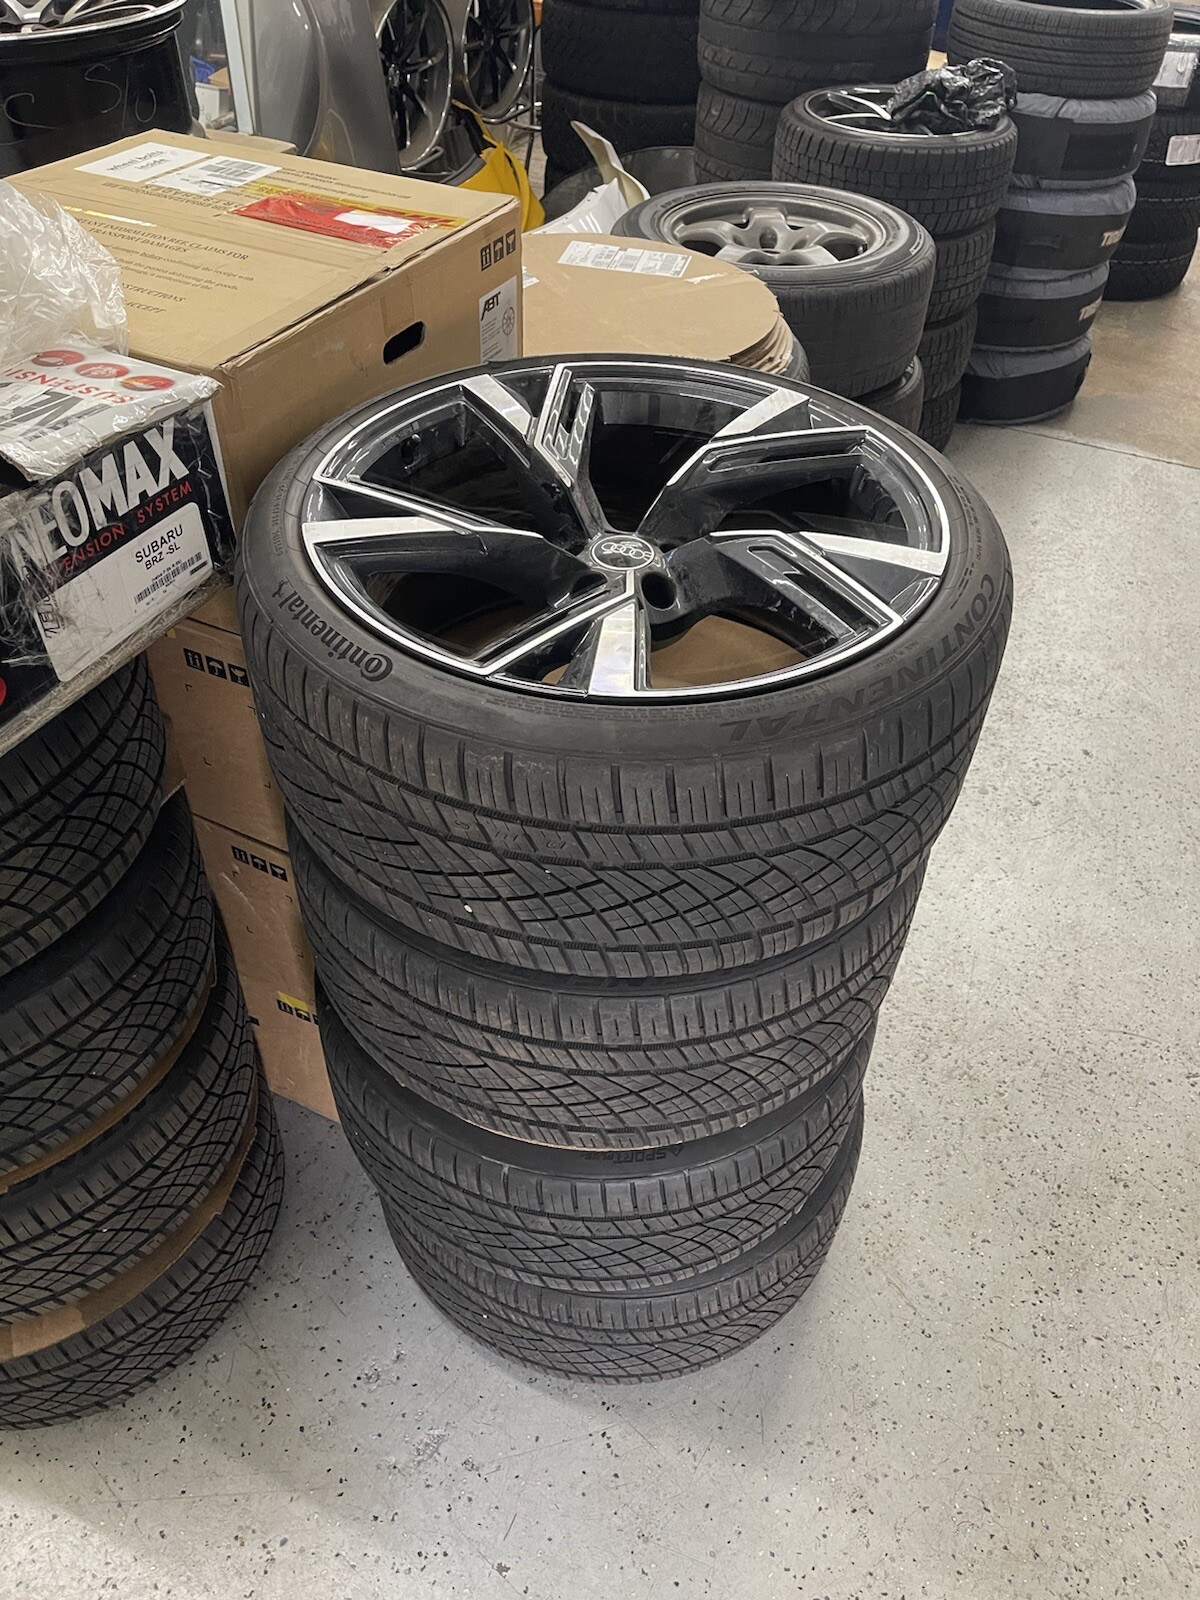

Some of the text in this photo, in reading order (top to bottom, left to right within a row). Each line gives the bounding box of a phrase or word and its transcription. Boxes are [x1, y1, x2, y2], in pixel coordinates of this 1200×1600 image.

[88, 227, 143, 246] TRANSPORT
[226, 251, 249, 261] FOR
[481, 290, 502, 321] ABT
[136, 480, 193, 524] SYSTEM
[134, 523, 184, 564] SUBARU
[144, 550, 165, 571] BRZ
[277, 590, 394, 682] Continental
[719, 573, 997, 742] CONTINENTAL
